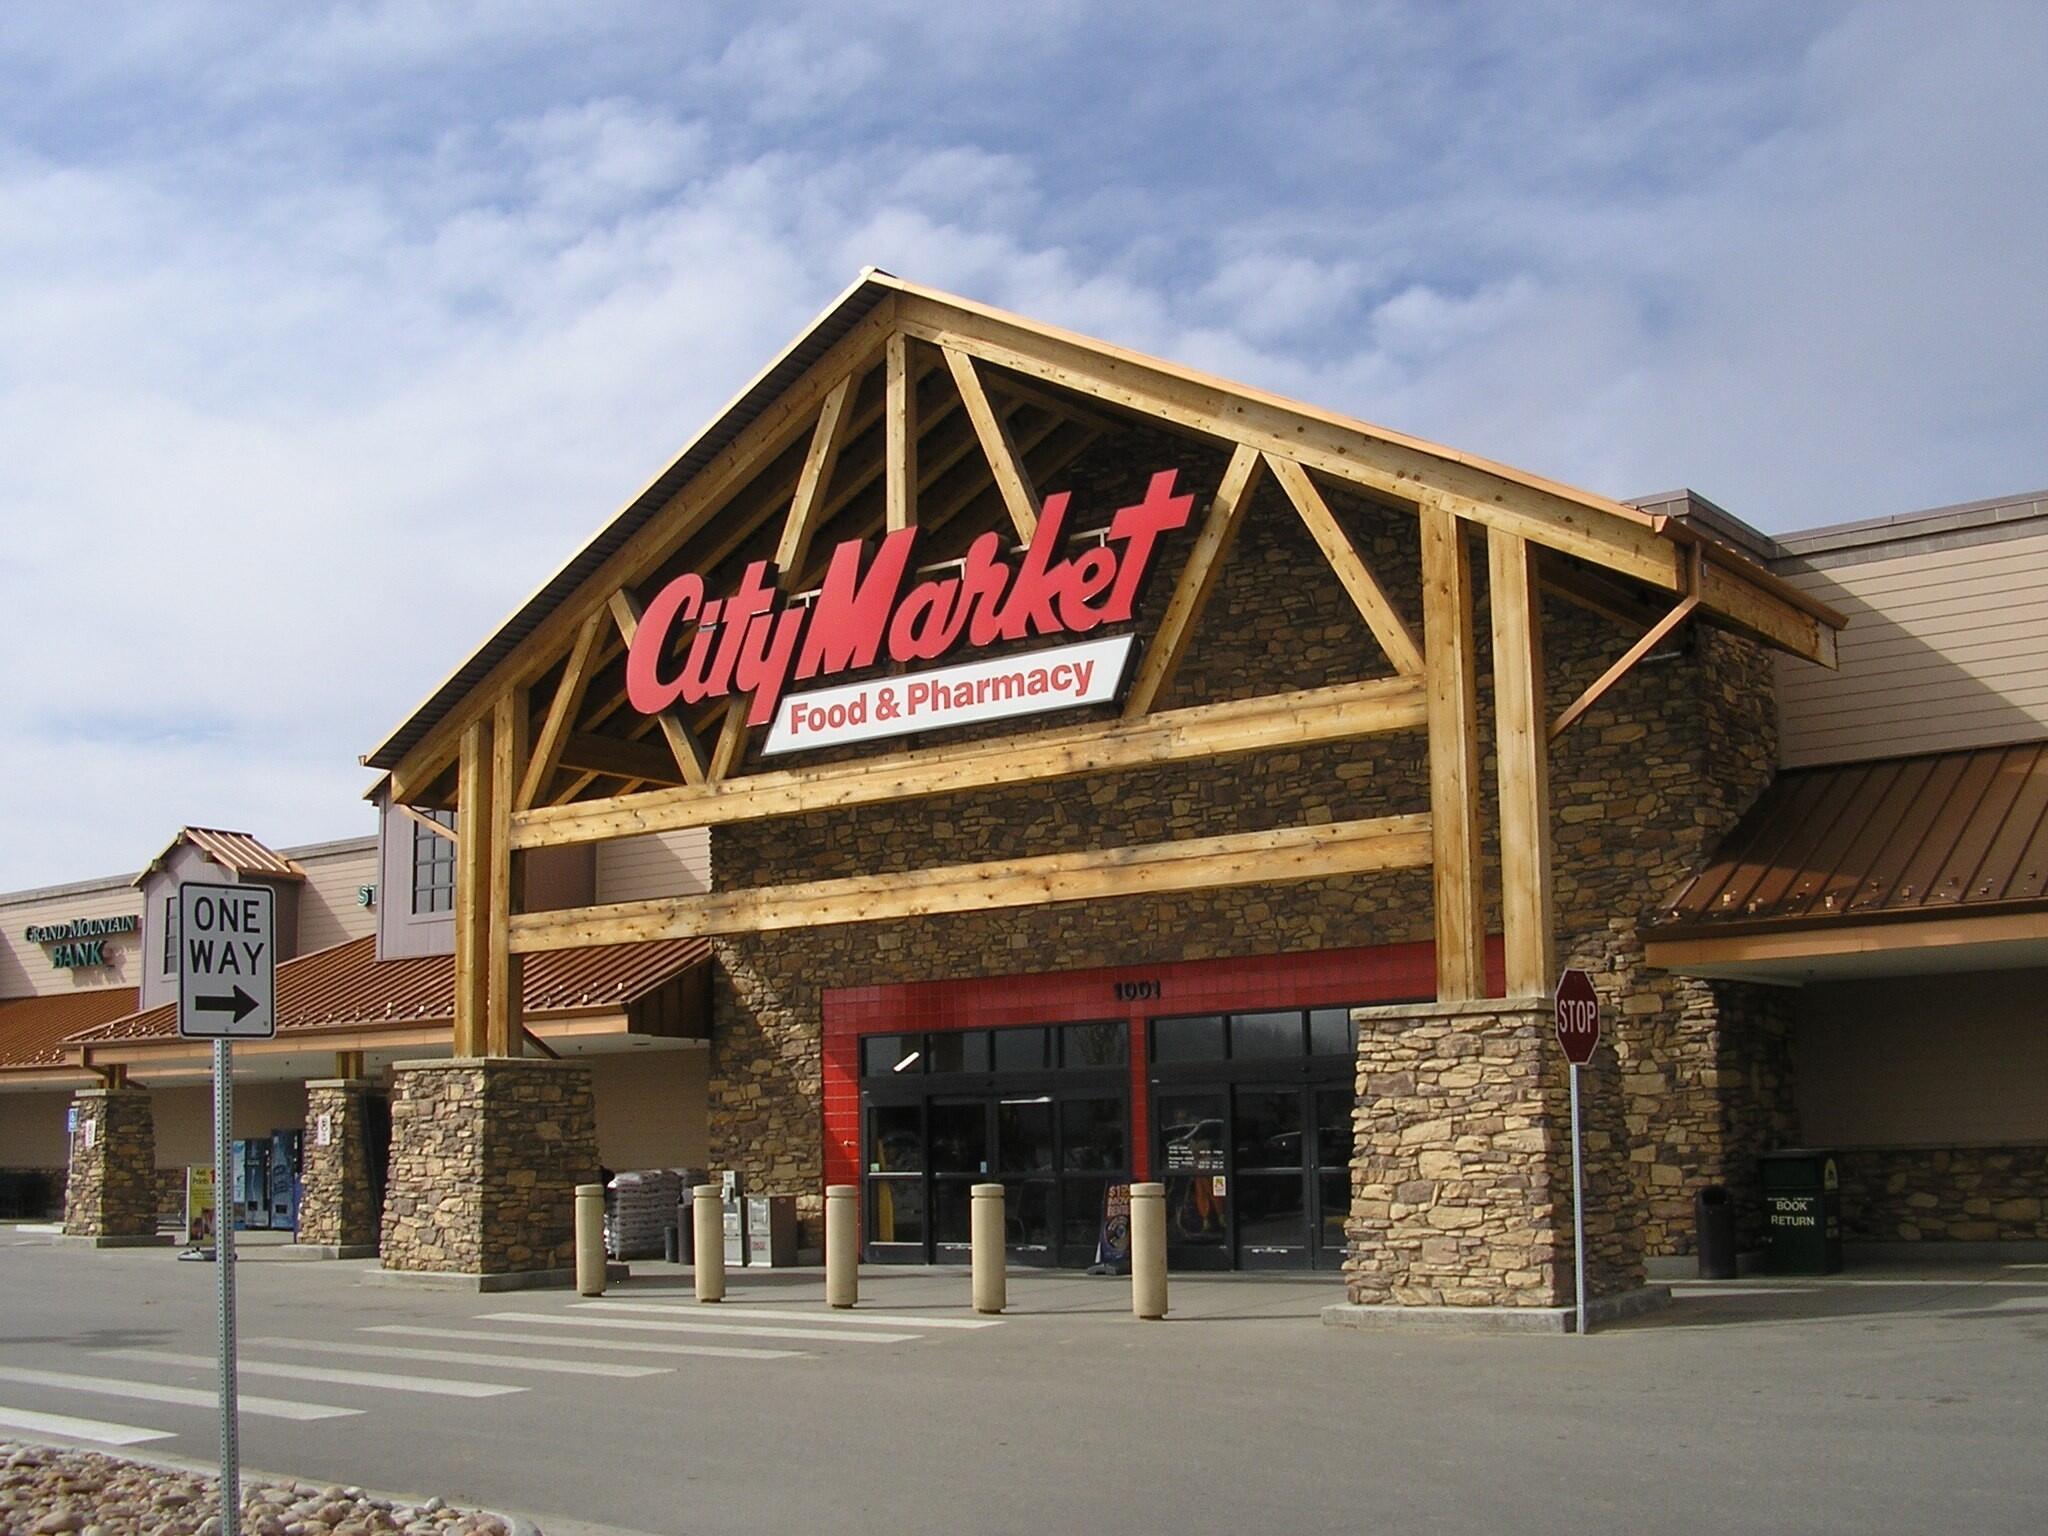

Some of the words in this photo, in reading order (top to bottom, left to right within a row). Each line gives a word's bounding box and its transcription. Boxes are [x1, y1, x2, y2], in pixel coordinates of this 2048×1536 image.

[626, 560, 805, 727] City
[793, 467, 1195, 680] Market
[791, 692, 867, 735] Food
[875, 688, 901, 722] &
[907, 659, 1095, 716] Pharmacy
[25, 924, 67, 943] GRAND
[69, 915, 138, 939] MOUNTAIN
[194, 896, 261, 934] ONE
[52, 940, 107, 969] BANK
[189, 938, 265, 976] WAY
[1114, 979, 1161, 1001] 1001
[1559, 999, 1596, 1033] STOP
[1771, 1215, 1815, 1226] RETURN
[1776, 1200, 1807, 1211] BOOK
